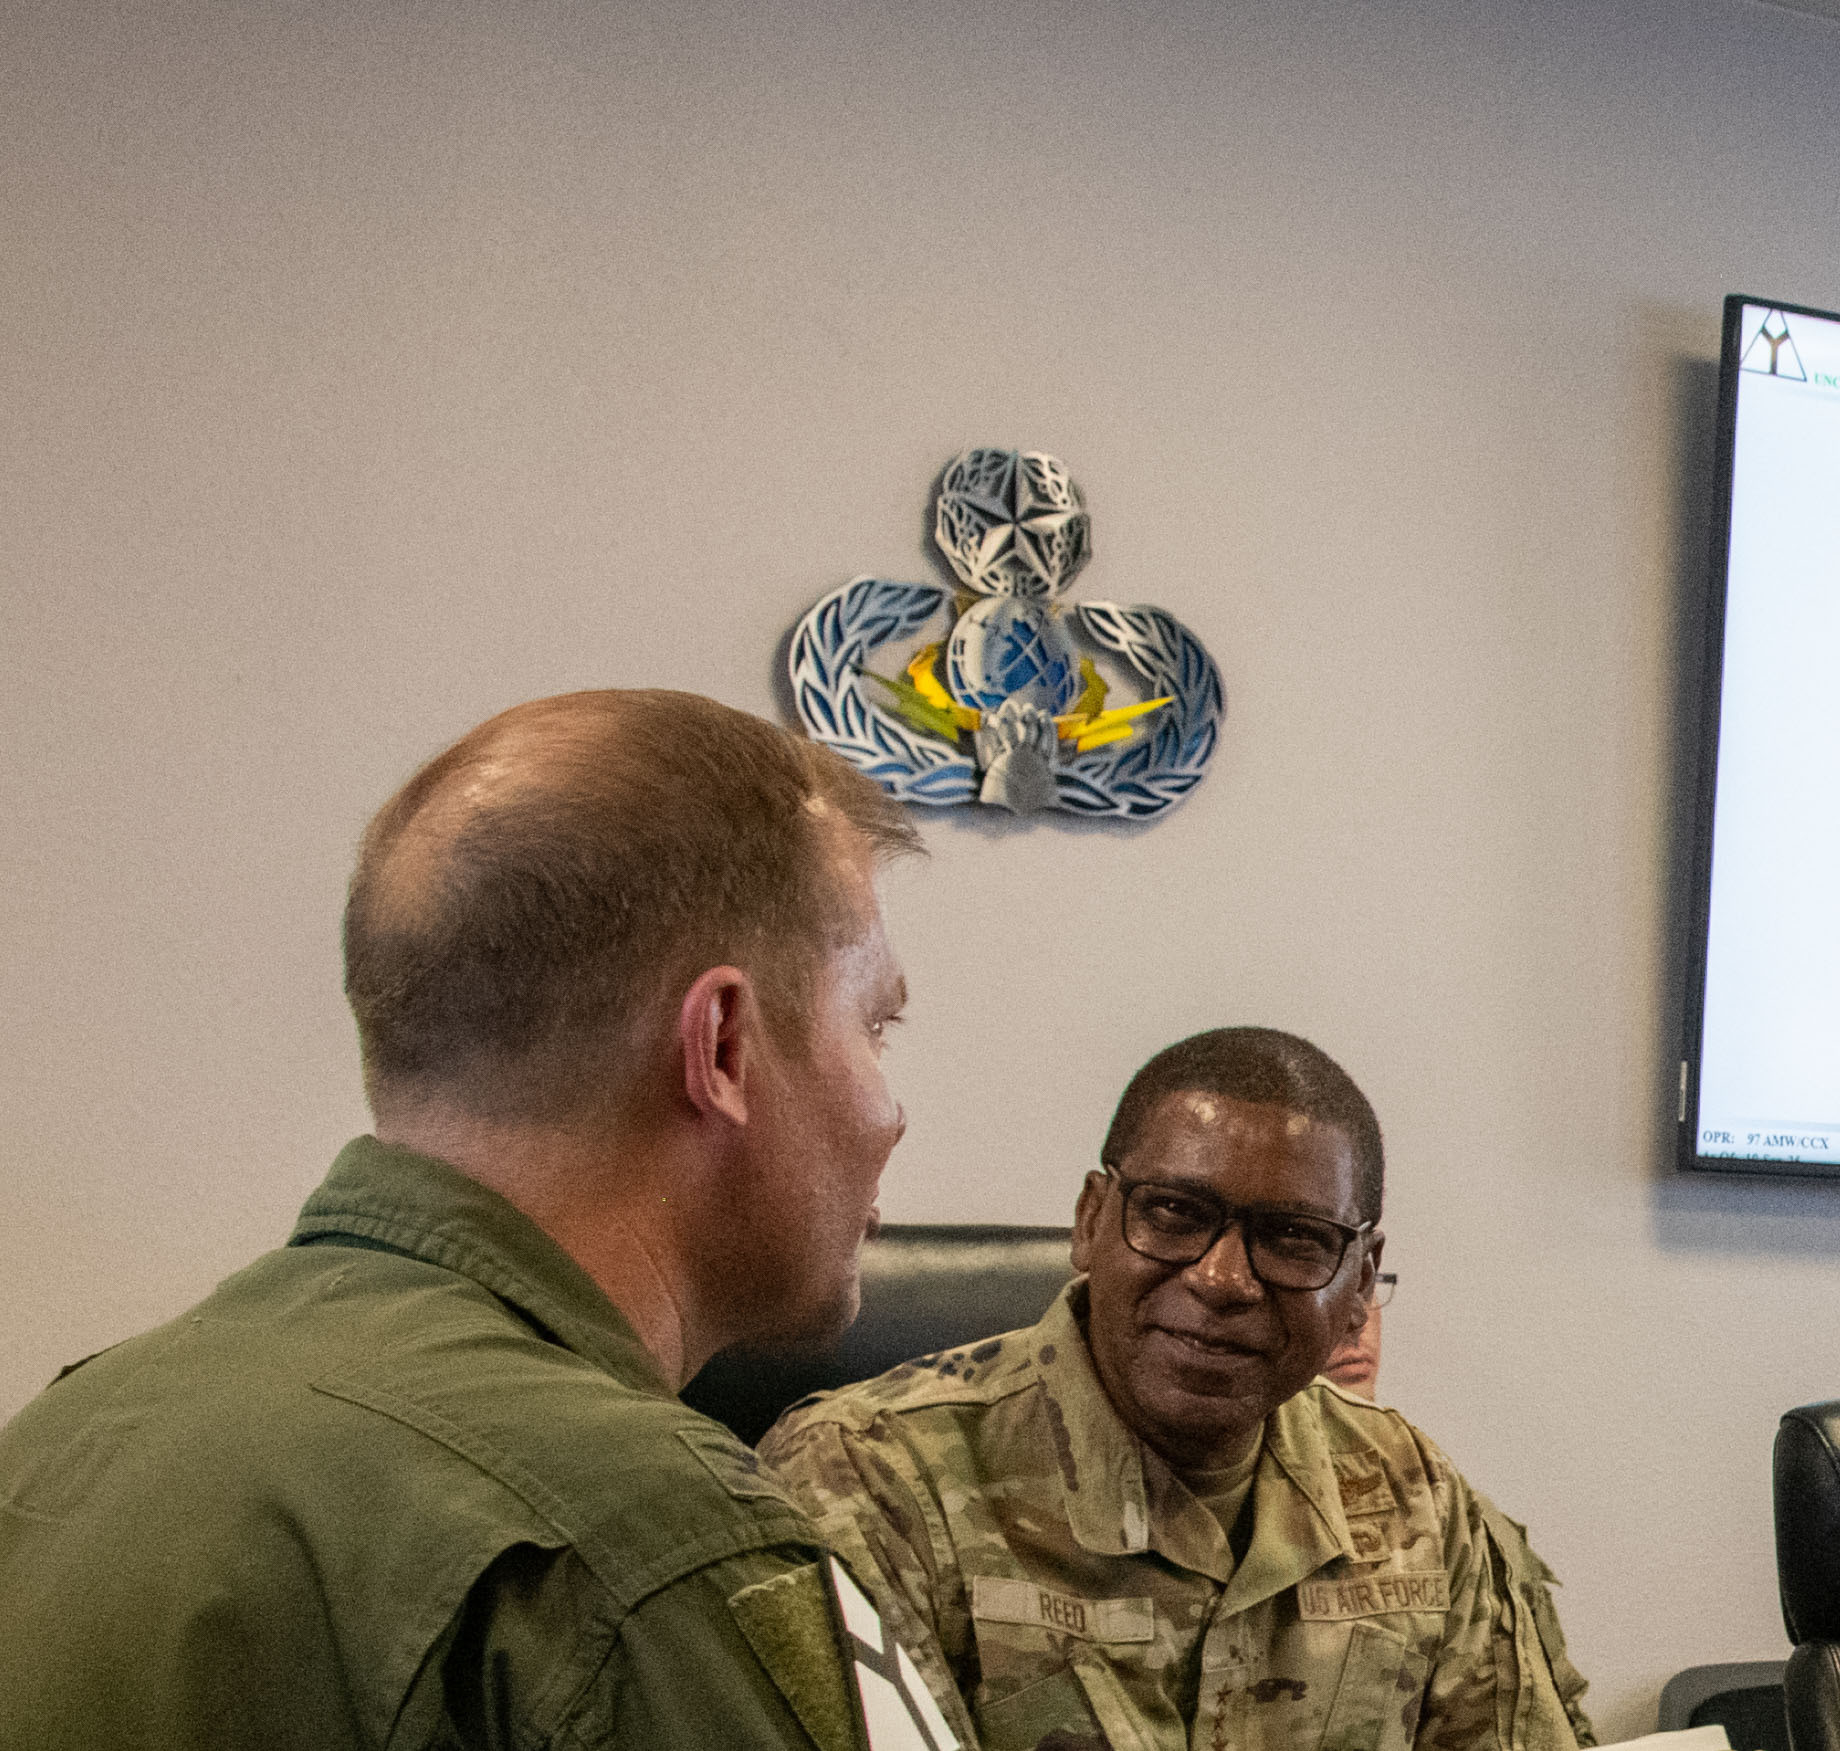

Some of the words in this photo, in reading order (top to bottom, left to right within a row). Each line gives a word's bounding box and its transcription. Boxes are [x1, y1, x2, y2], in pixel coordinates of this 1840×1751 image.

[1702, 1130, 1735, 1145] OPR:
[1747, 1133, 1761, 1146] 97
[1039, 1592, 1086, 1633] REED
[1337, 1581, 1376, 1613] AIR
[1378, 1576, 1444, 1609] FORCE
